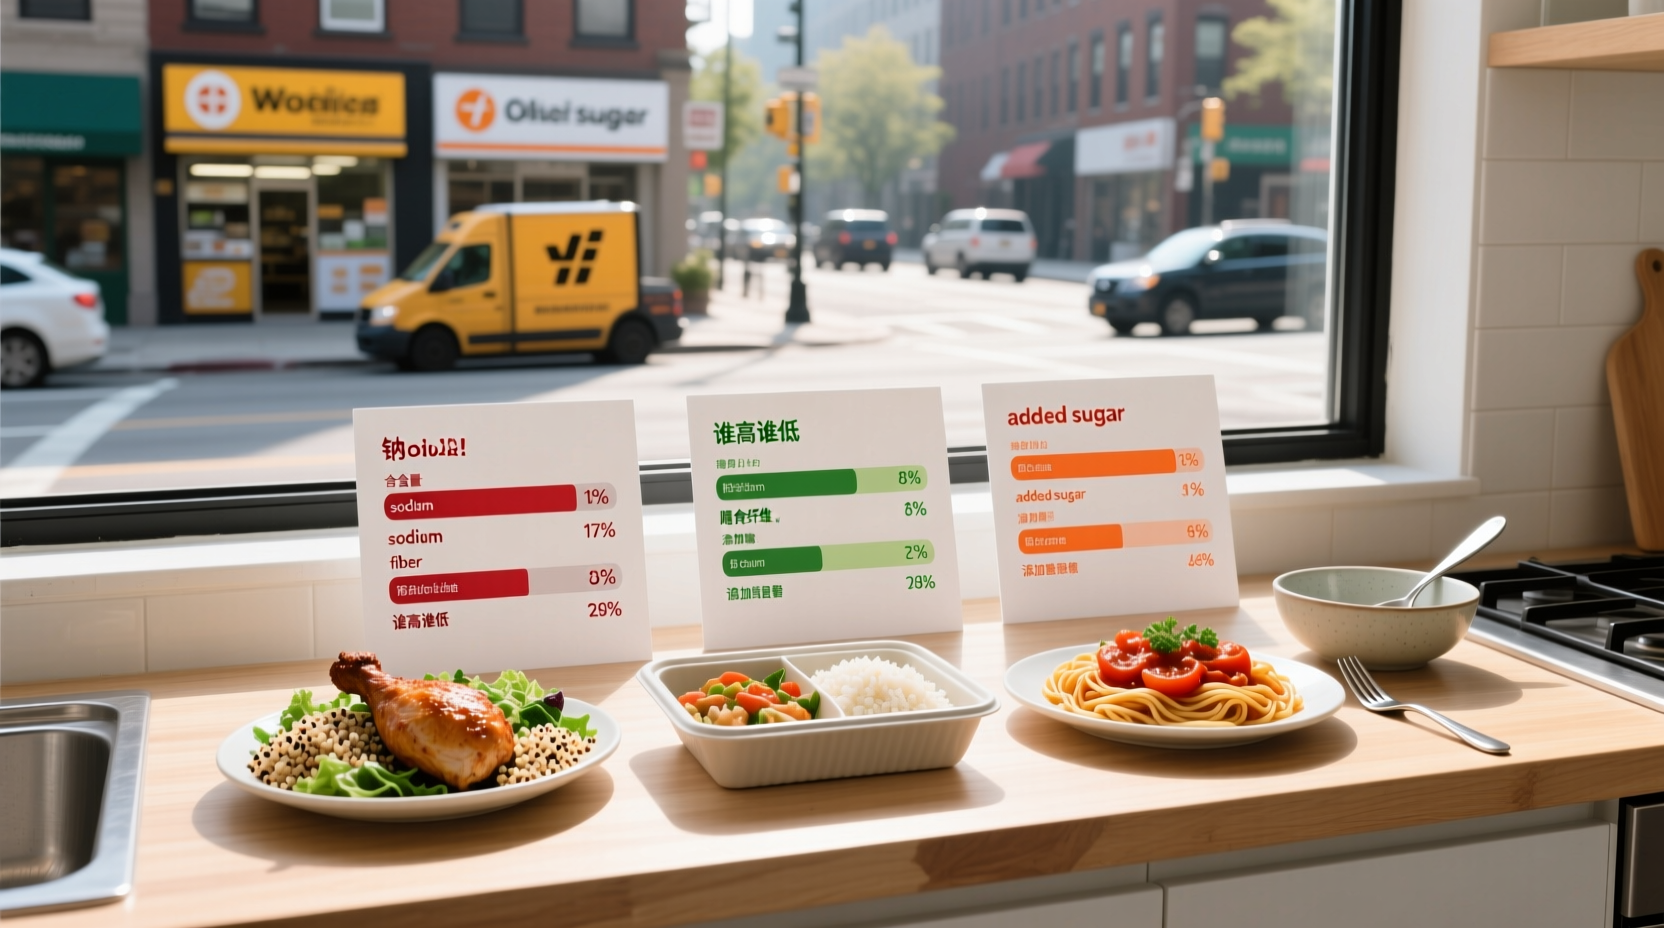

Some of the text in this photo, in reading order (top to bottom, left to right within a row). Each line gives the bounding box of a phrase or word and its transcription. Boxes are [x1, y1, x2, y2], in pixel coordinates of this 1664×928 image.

[1007, 405, 1125, 427] added sugar
[713, 419, 800, 445] 谁高谁低
[898, 470, 921, 485] 8%
[584, 488, 609, 505] 1%
[1016, 489, 1087, 503] added sugar
[388, 529, 443, 546] sodium
[583, 521, 616, 538] 17%
[904, 544, 928, 560] 2%
[389, 555, 423, 570] fiber
